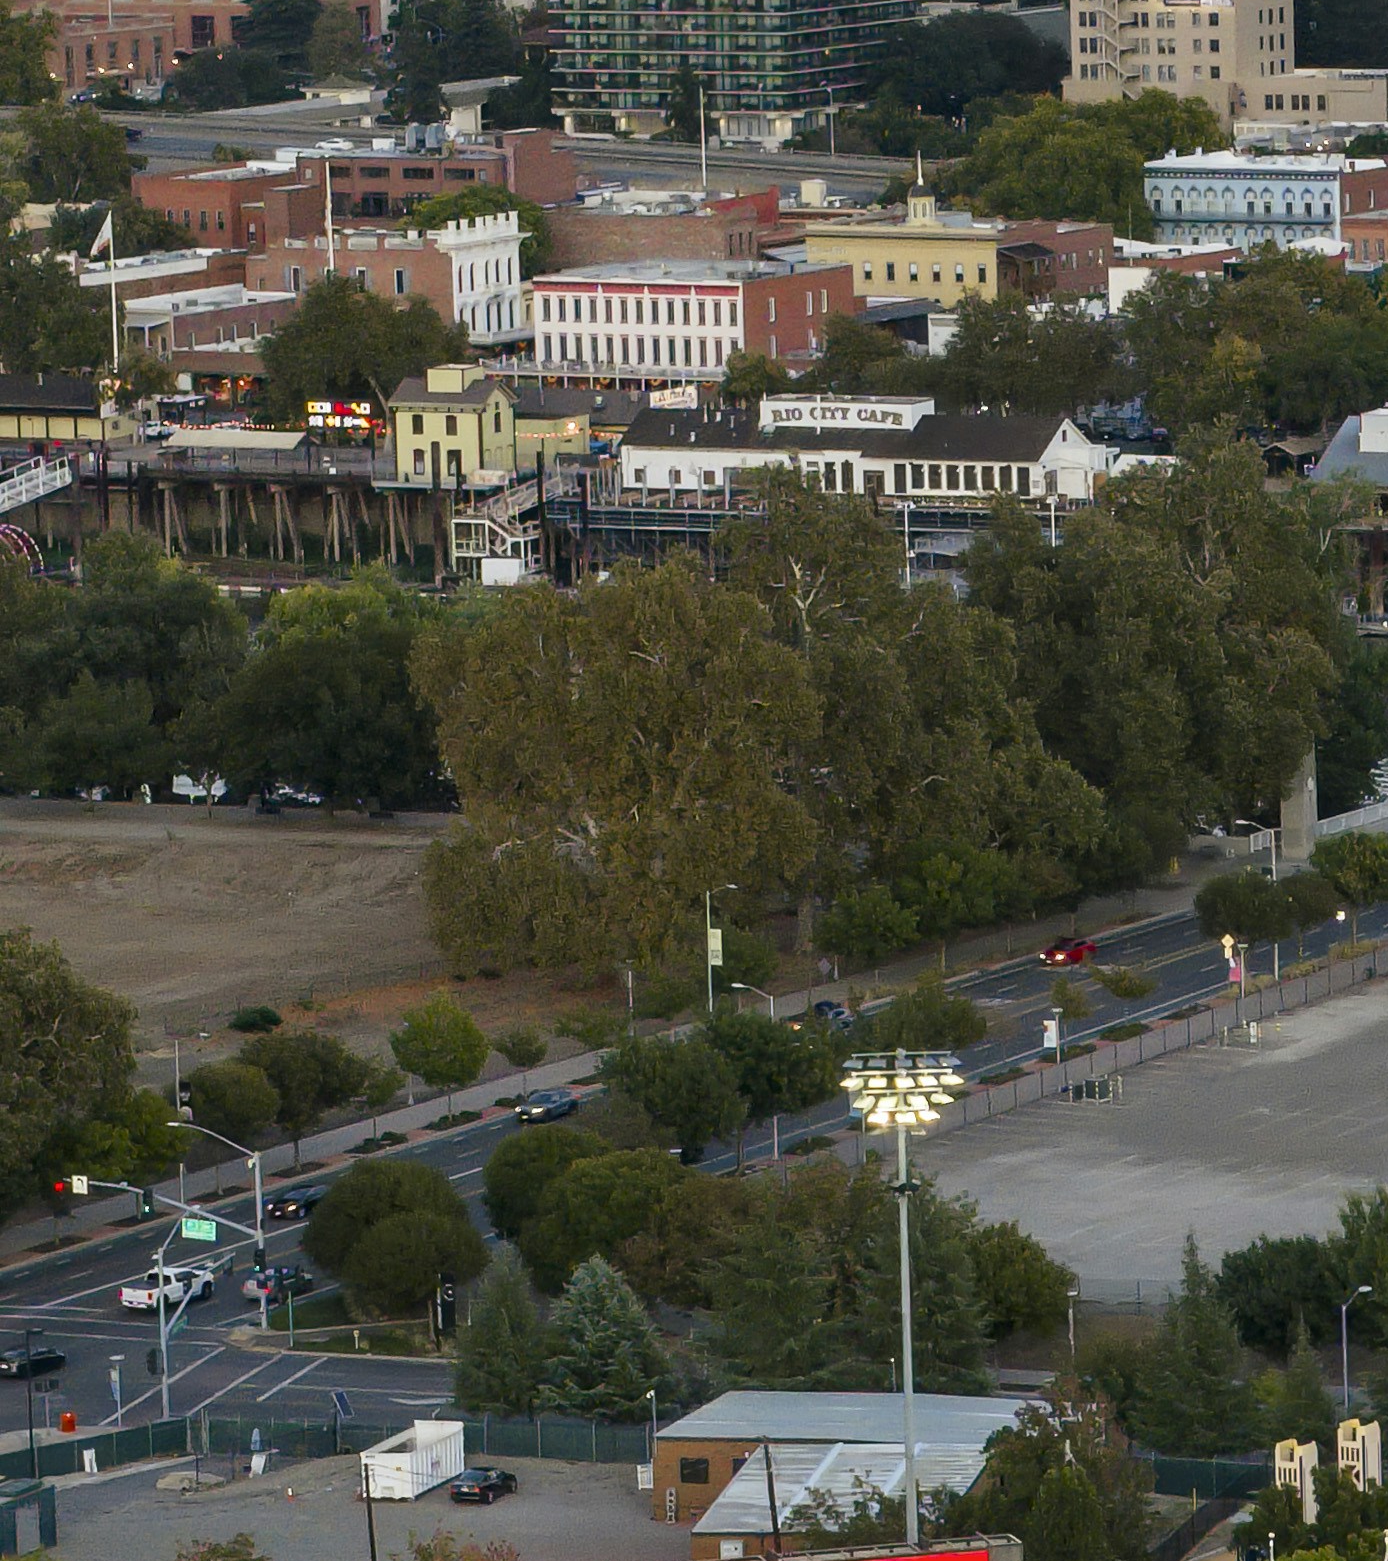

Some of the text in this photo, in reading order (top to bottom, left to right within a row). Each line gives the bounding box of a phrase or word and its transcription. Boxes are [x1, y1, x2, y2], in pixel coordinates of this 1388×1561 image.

[771, 406, 903, 426] RIO CITY CAFE
